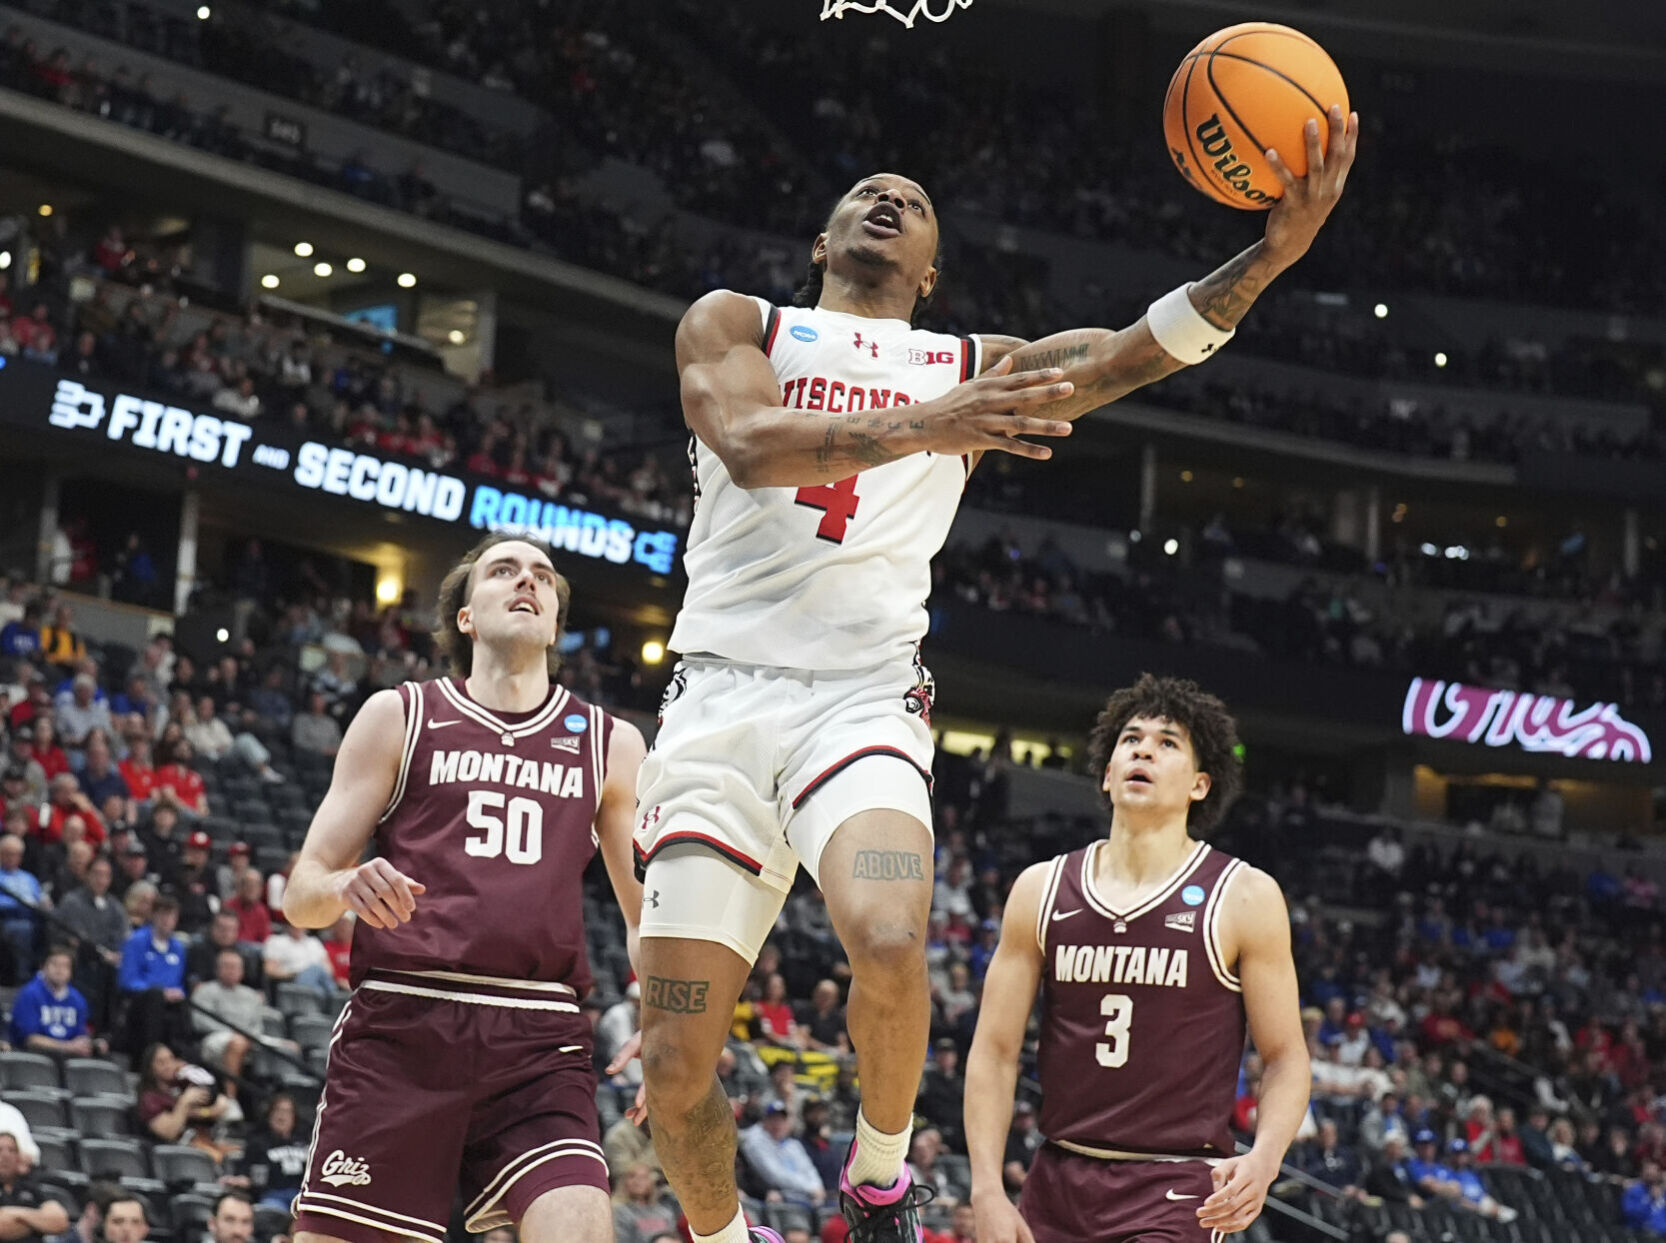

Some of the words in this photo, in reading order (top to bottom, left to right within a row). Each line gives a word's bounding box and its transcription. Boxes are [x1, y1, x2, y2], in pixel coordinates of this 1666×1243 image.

[107, 393, 253, 468] FIRST
[294, 441, 466, 522] SECOND
[469, 484, 635, 564] ROUNDS
[794, 475, 860, 545] 4
[429, 750, 583, 798] MONTANA
[465, 790, 543, 865] 50
[853, 850, 924, 881] ABOVE
[646, 975, 709, 1014] RISE
[1055, 944, 1188, 988] MONTANA
[1095, 993, 1133, 1068] 3
